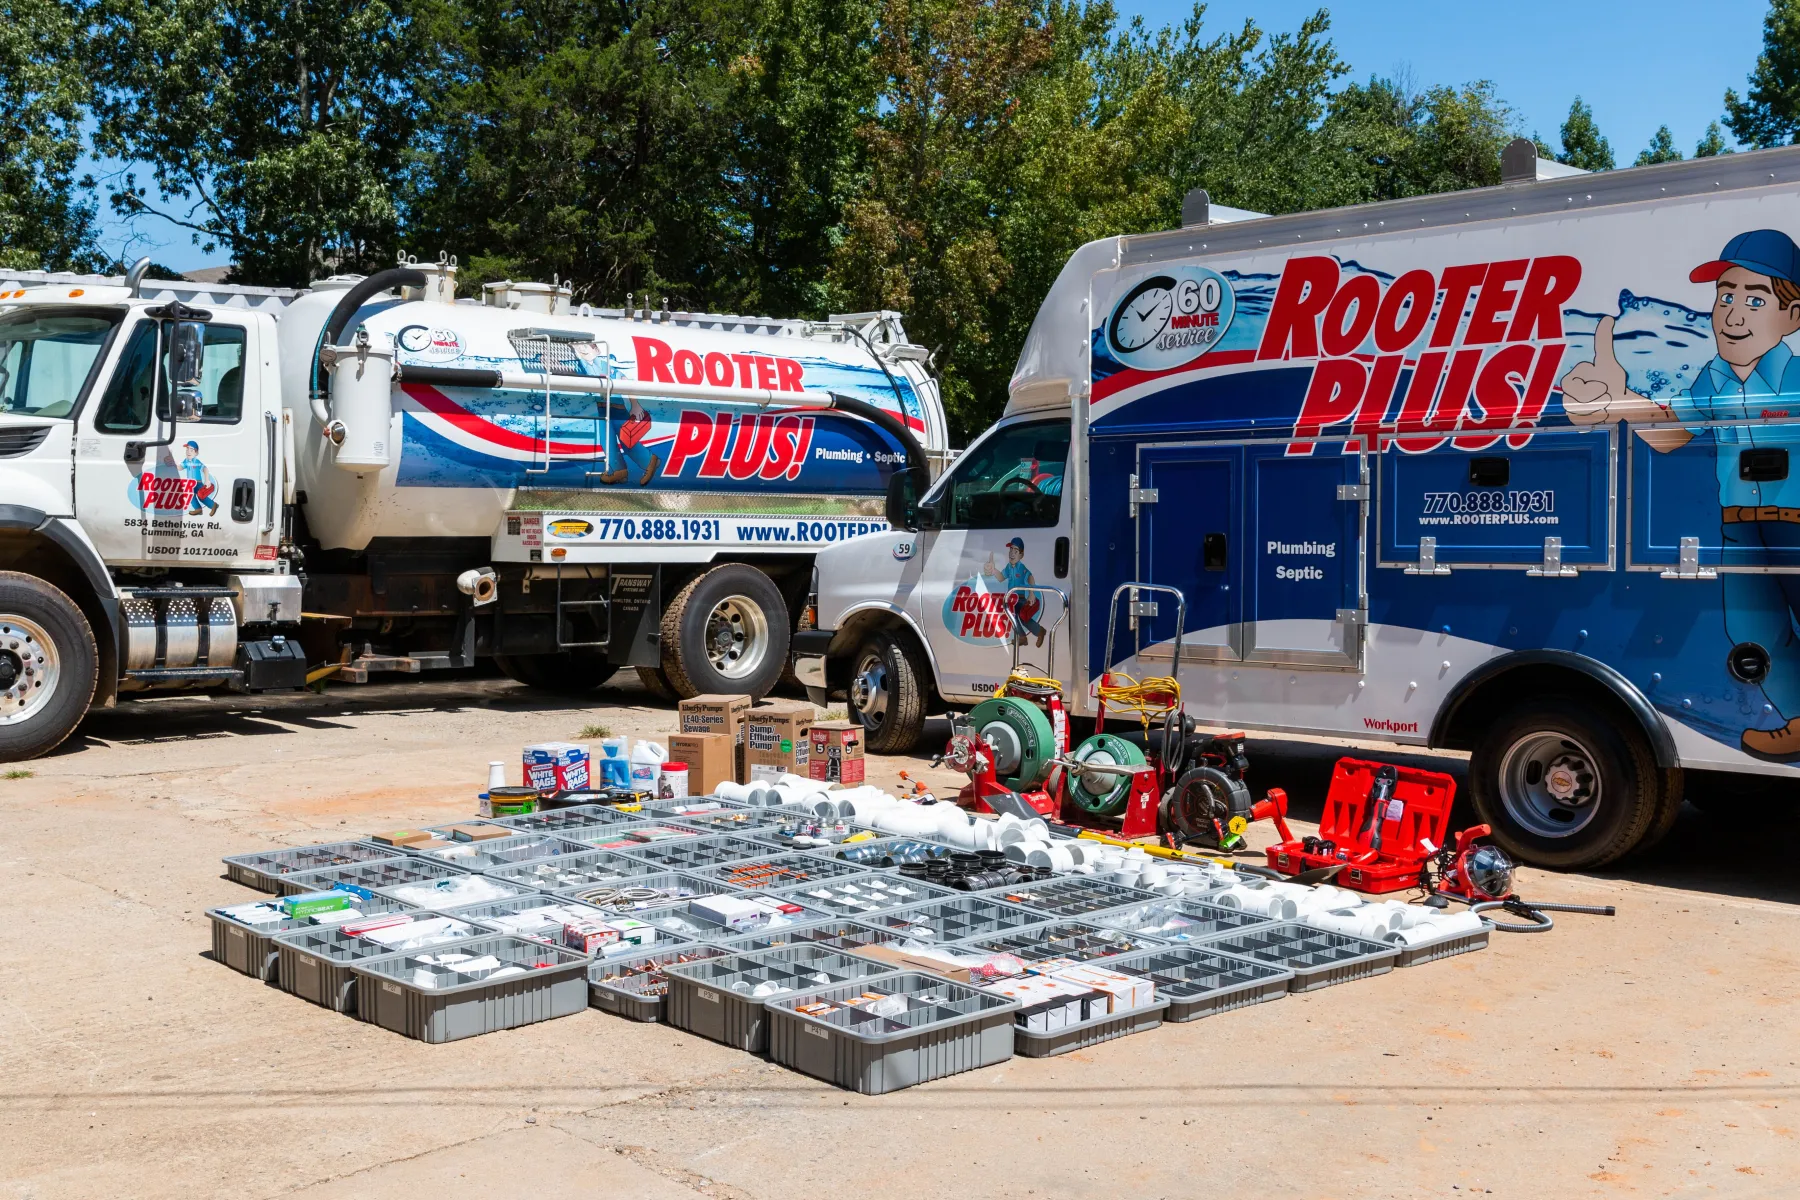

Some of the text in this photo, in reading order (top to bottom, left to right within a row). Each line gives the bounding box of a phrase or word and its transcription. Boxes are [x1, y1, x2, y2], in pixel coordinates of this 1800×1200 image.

[1177, 278, 1221, 314] 60
[1255, 254, 1582, 362] ROOTER
[1171, 312, 1219, 329] MINUTE
[431, 328, 457, 342] 60
[1156, 328, 1216, 350] service
[631, 335, 805, 392] ROOTER
[1284, 342, 1569, 457] PLUS!
[661, 409, 815, 482] PLUS!
[815, 447, 906, 465] Plumbing Septic
[137, 472, 197, 493] ROOTER
[143, 491, 194, 511] PLUS!
[1423, 490, 1555, 513] 770.888.1931
[124, 519, 222, 530] 5834 Bethelview Rd.
[1419, 514, 1559, 525] www.ROOTERPLUS.com
[141, 528, 204, 538] Cumming, GA
[600, 518, 720, 541] 770.888.1931
[147, 546, 239, 557] USDOT 1017100GA
[898, 543, 911, 554] 59
[1267, 541, 1336, 558] Plumbing
[1276, 566, 1324, 582] Septic
[611, 574, 652, 594] TRANSWAY
[952, 586, 1018, 613] ROOTER
[960, 612, 1013, 639] PLUS!
[682, 704, 724, 713] Liberty Pumps
[683, 714, 724, 724] LE40-Series
[769, 716, 790, 724] Pumps
[1363, 718, 1418, 733] Workport
[749, 724, 776, 734] Sump/
[749, 733, 780, 742] Effluent
[749, 741, 772, 750] Pump
[817, 743, 824, 753] 5
[528, 770, 554, 780] WHITE
[562, 766, 586, 781] WHITE
[568, 772, 588, 790] RAGS
[533, 776, 556, 790] RAGS
